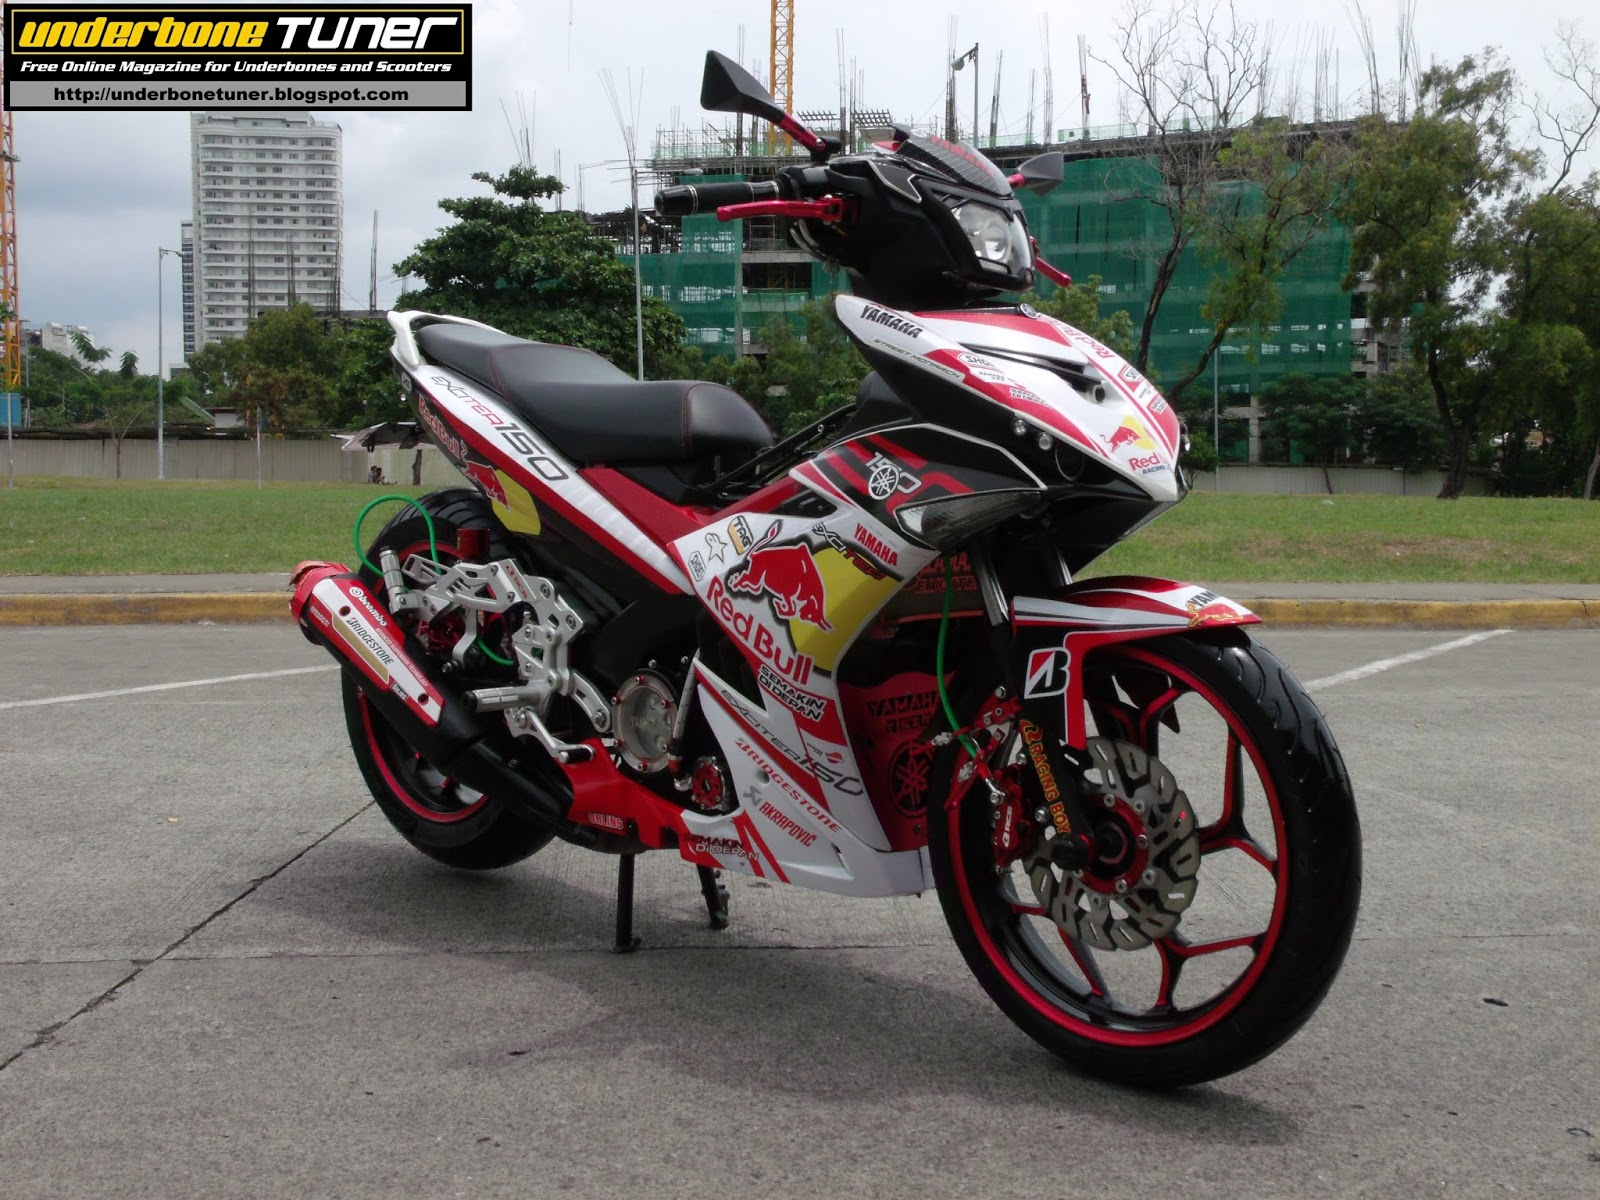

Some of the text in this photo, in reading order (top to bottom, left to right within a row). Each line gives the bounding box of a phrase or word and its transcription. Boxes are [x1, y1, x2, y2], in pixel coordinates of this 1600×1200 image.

[860, 305, 924, 338] YAMAHA
[874, 338, 911, 358] STREET
[912, 355, 962, 379] MONARCH
[1128, 452, 1161, 472] Red
[1142, 464, 1166, 476] RACING
[854, 522, 898, 566] YAMAHA
[358, 595, 388, 627] brembo
[706, 575, 816, 686] Red Bull
[346, 616, 395, 667] BRIDGESTONE
[758, 673, 825, 722] DI DEPAN
[760, 664, 826, 710] SEMAKIN
[735, 738, 843, 833] BRIDGESTONE
[1029, 743, 1072, 834] RACING BOY
[684, 832, 744, 849] SEMAKIN
